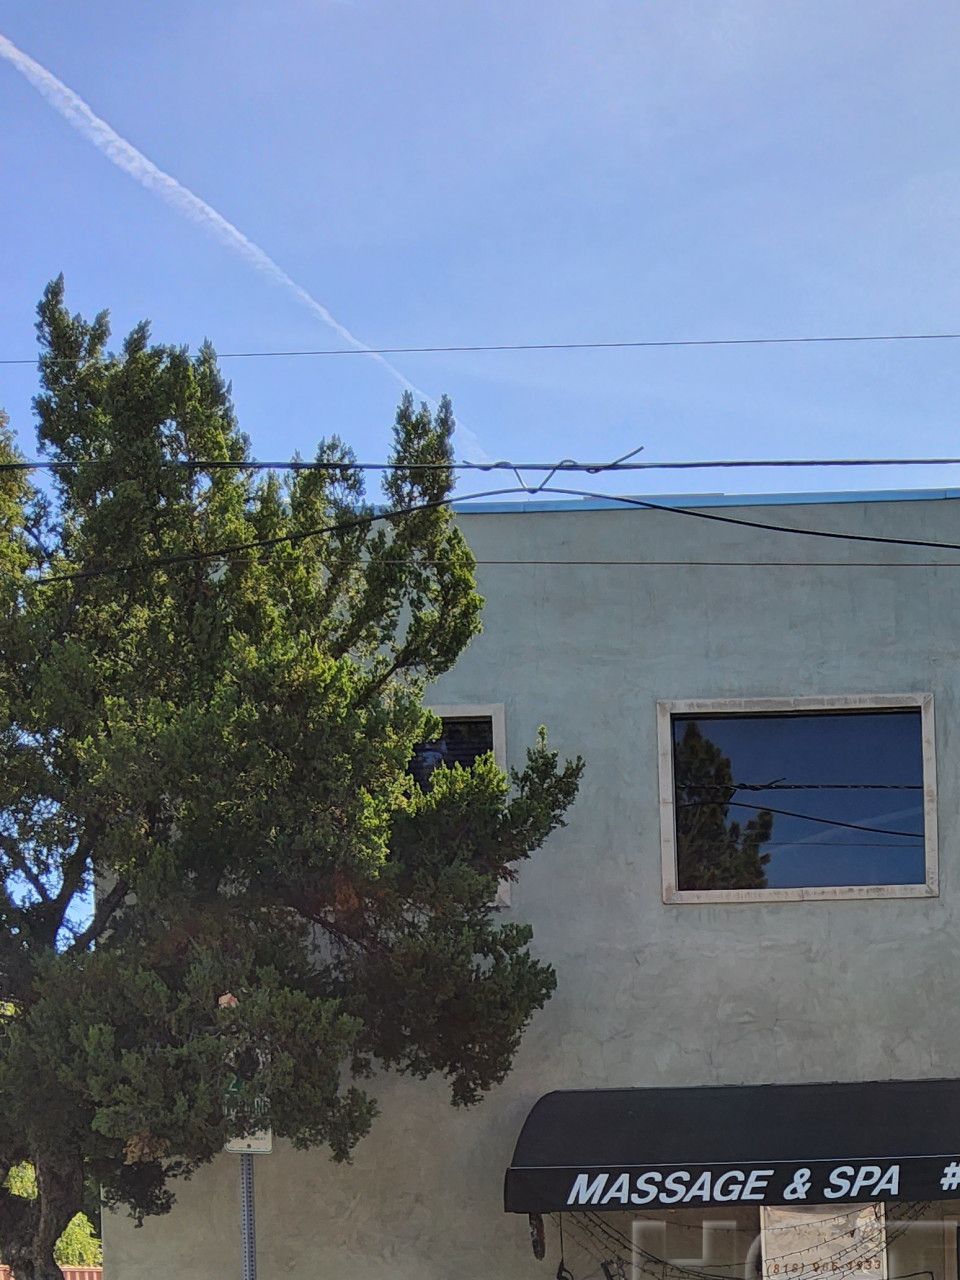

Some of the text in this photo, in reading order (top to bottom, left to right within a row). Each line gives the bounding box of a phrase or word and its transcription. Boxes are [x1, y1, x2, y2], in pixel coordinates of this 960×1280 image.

[566, 1168, 774, 1206] MASSAGE
[783, 1167, 812, 1201] &
[823, 1164, 901, 1198] SPA
